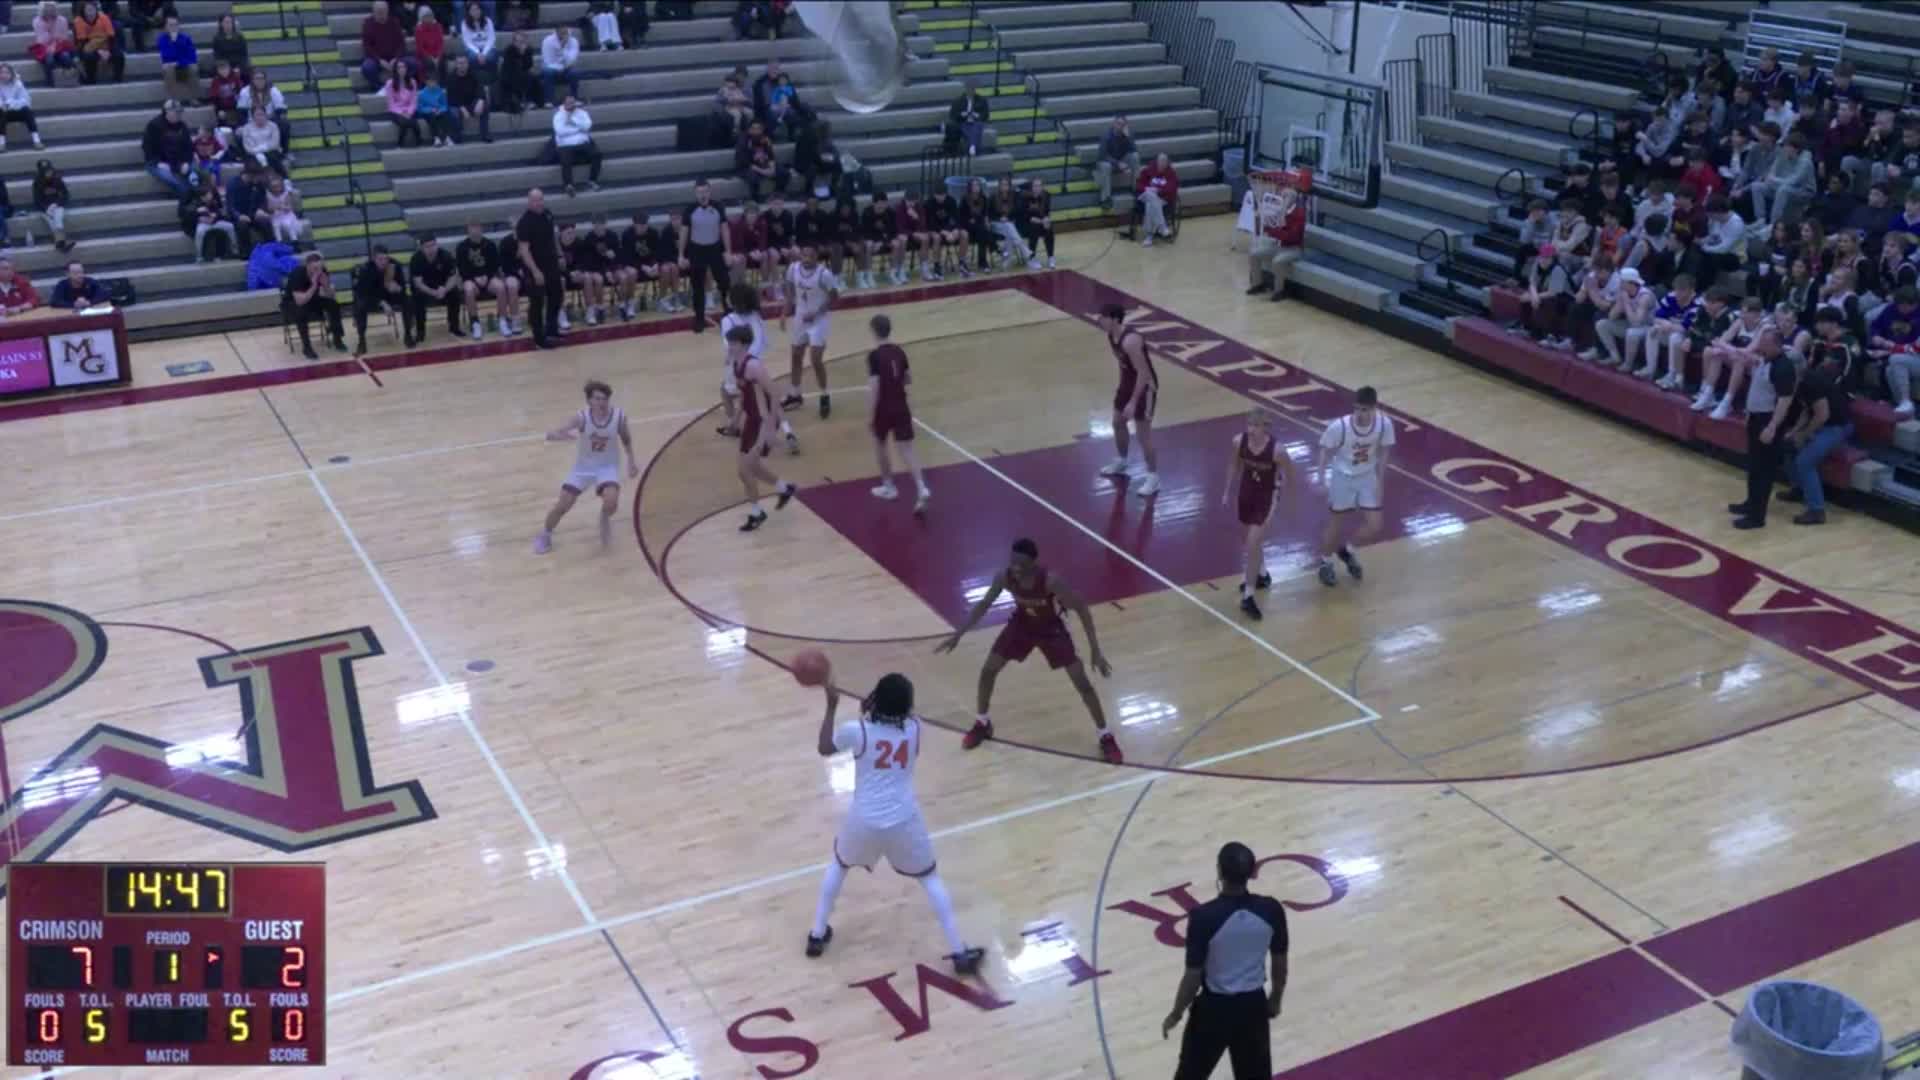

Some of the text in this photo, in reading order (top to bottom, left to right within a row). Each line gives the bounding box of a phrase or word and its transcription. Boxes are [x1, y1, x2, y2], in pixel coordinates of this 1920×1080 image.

[61, 337, 106, 374] MG
[1430, 456, 1920, 690] GROVE
[874, 739, 909, 769] 24
